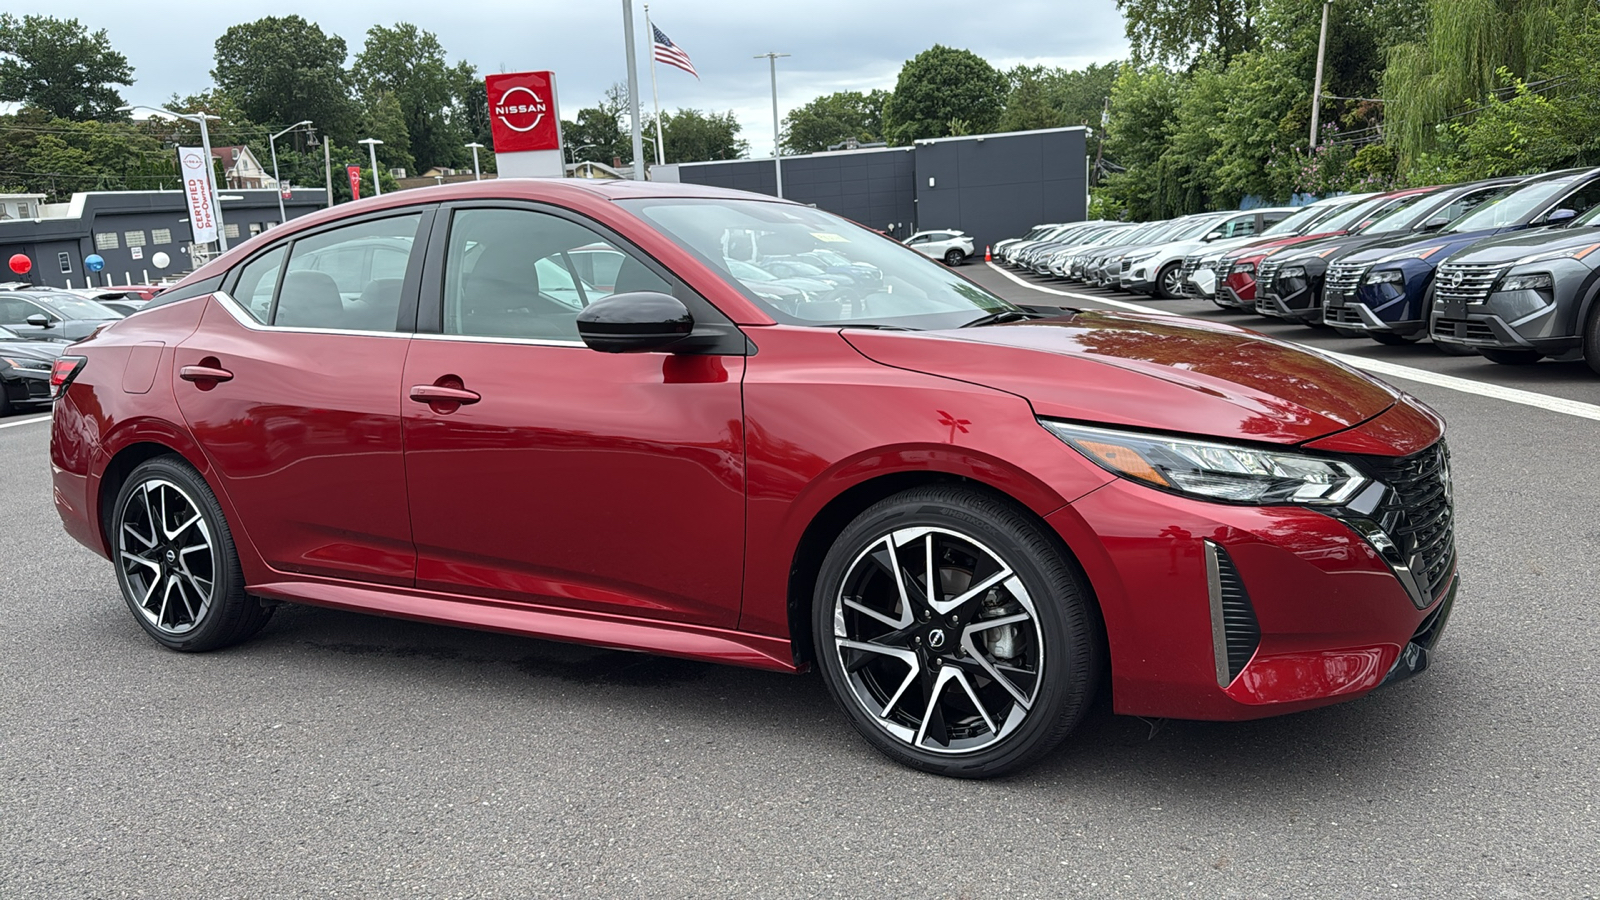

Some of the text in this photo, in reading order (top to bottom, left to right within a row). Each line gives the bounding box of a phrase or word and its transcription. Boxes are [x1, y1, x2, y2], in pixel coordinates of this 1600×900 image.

[495, 103, 546, 115] NISSAN
[188, 179, 204, 229] CERTIFIED
[197, 179, 212, 228] Pre-Owned
